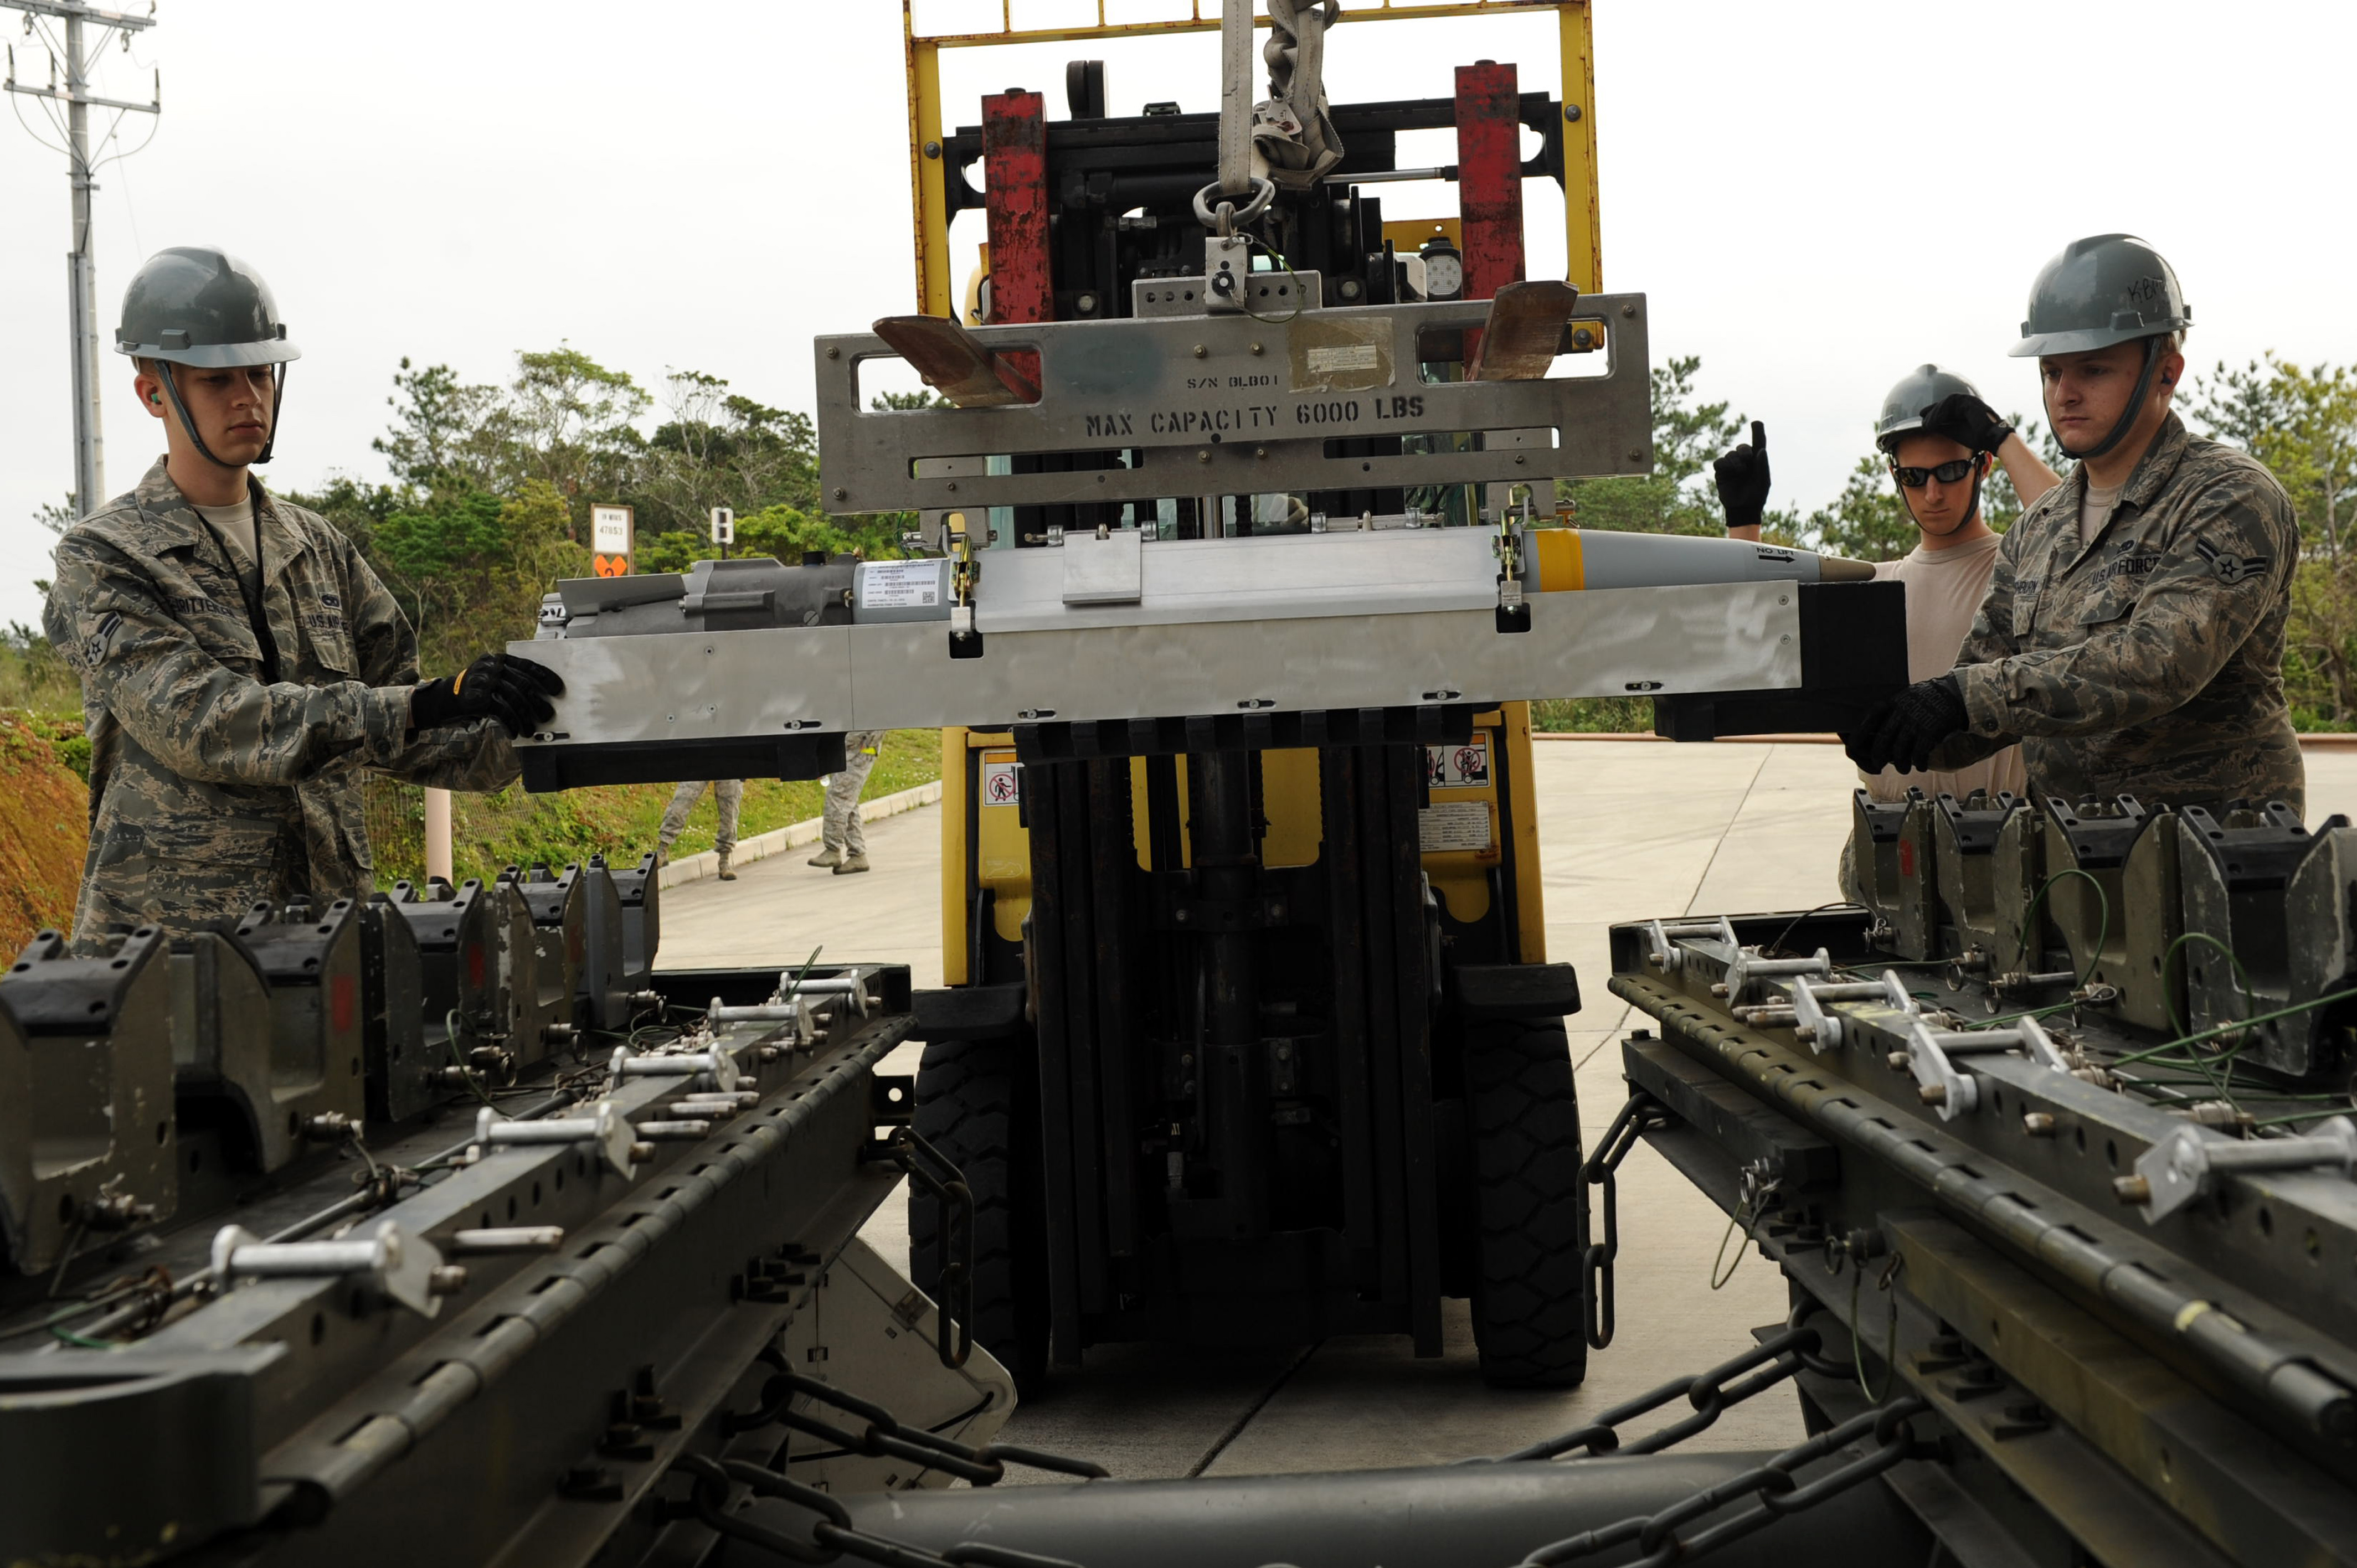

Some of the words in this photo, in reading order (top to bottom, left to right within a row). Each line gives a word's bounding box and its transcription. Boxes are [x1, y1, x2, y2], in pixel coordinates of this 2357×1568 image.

[1187, 377, 1217, 389] S/N
[1085, 414, 1133, 437] MAX
[1151, 405, 1277, 434] CAPACITY
[1296, 400, 1359, 424] 6000
[1375, 395, 1424, 420] LBS
